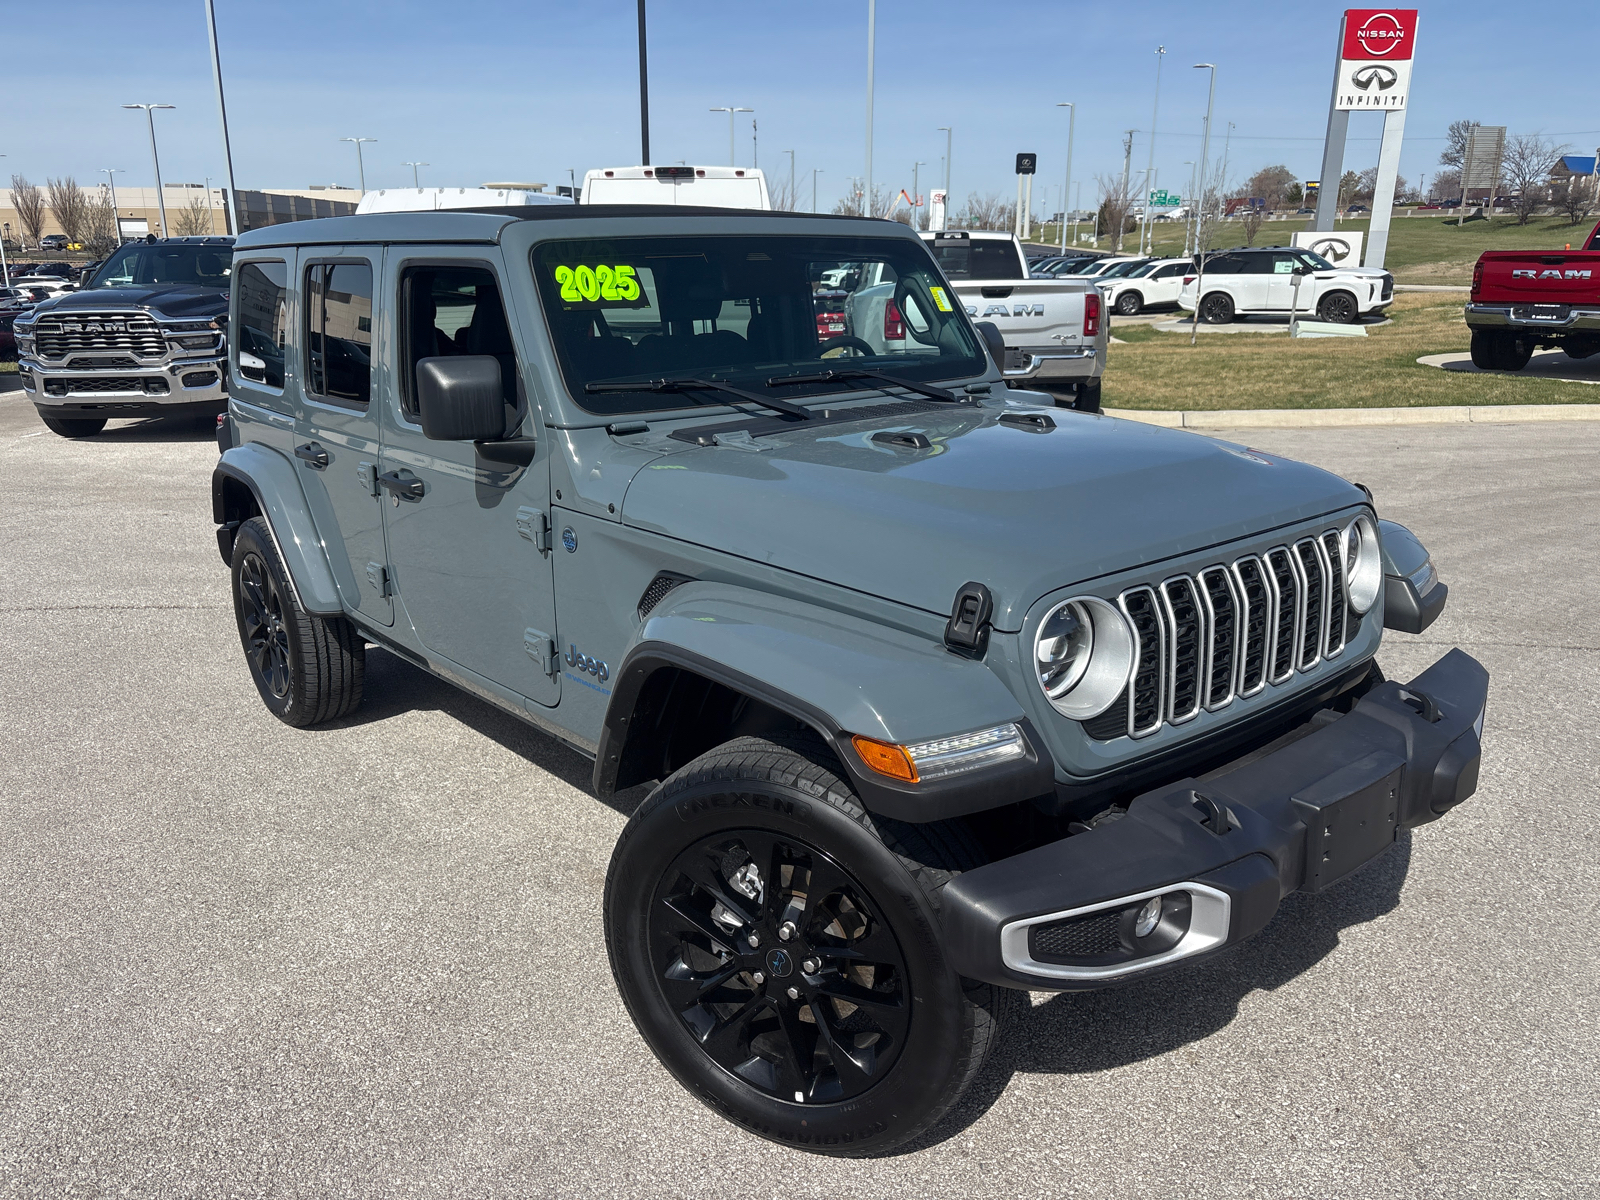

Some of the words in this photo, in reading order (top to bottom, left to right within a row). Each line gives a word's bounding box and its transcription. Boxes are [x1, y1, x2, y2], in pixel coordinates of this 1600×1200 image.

[1357, 30, 1404, 39] NISSAN
[1339, 95, 1404, 106] INFINITI
[1512, 269, 1592, 280] RAM
[554, 264, 640, 302] 2025
[63, 323, 126, 332] RAM
[565, 643, 609, 684] Jeep
[691, 791, 794, 816] NEXEN
